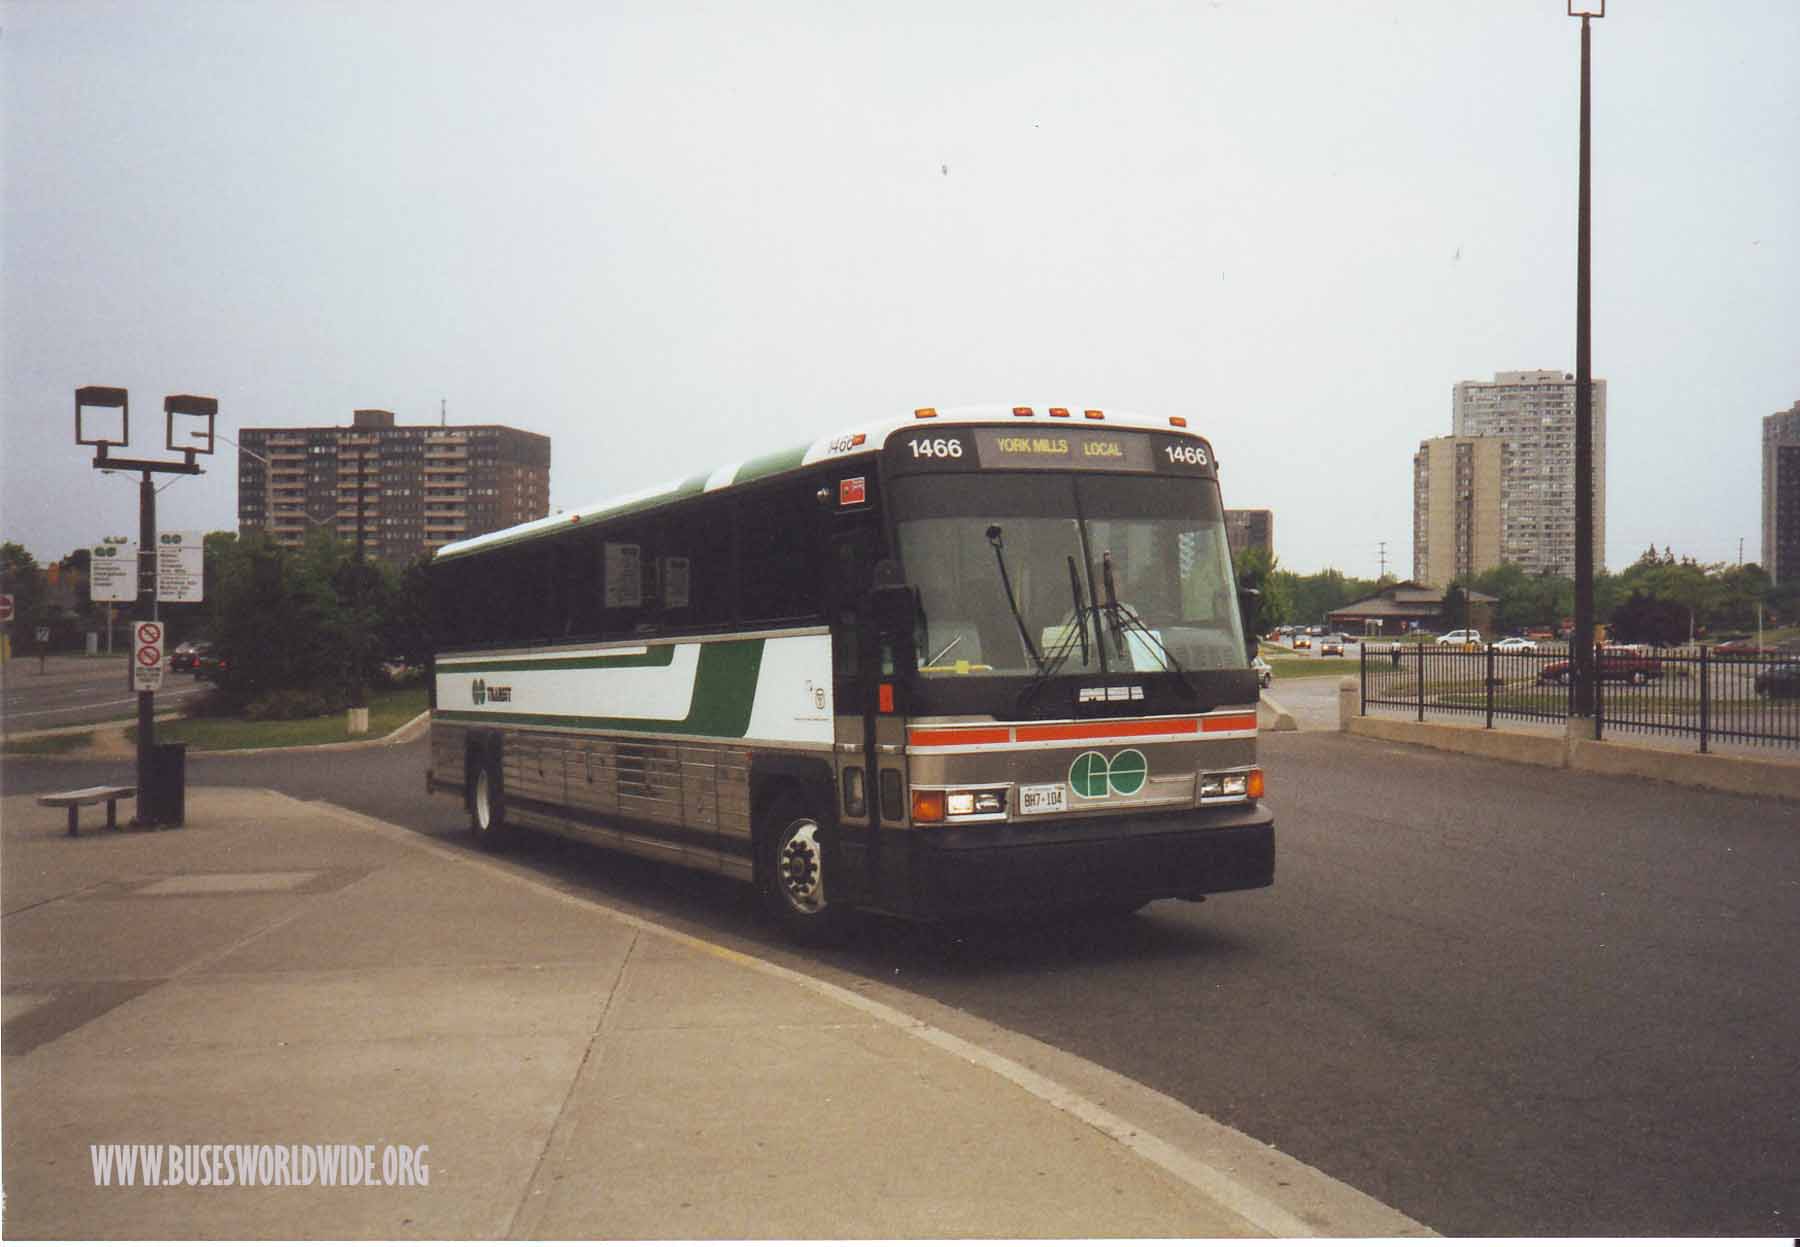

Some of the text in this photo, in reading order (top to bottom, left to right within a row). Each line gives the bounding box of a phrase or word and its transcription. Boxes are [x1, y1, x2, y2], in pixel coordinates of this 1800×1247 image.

[908, 439, 963, 458] 1466
[997, 438, 1122, 456] YORK MILLS LOCAL
[1165, 445, 1208, 465] 1466
